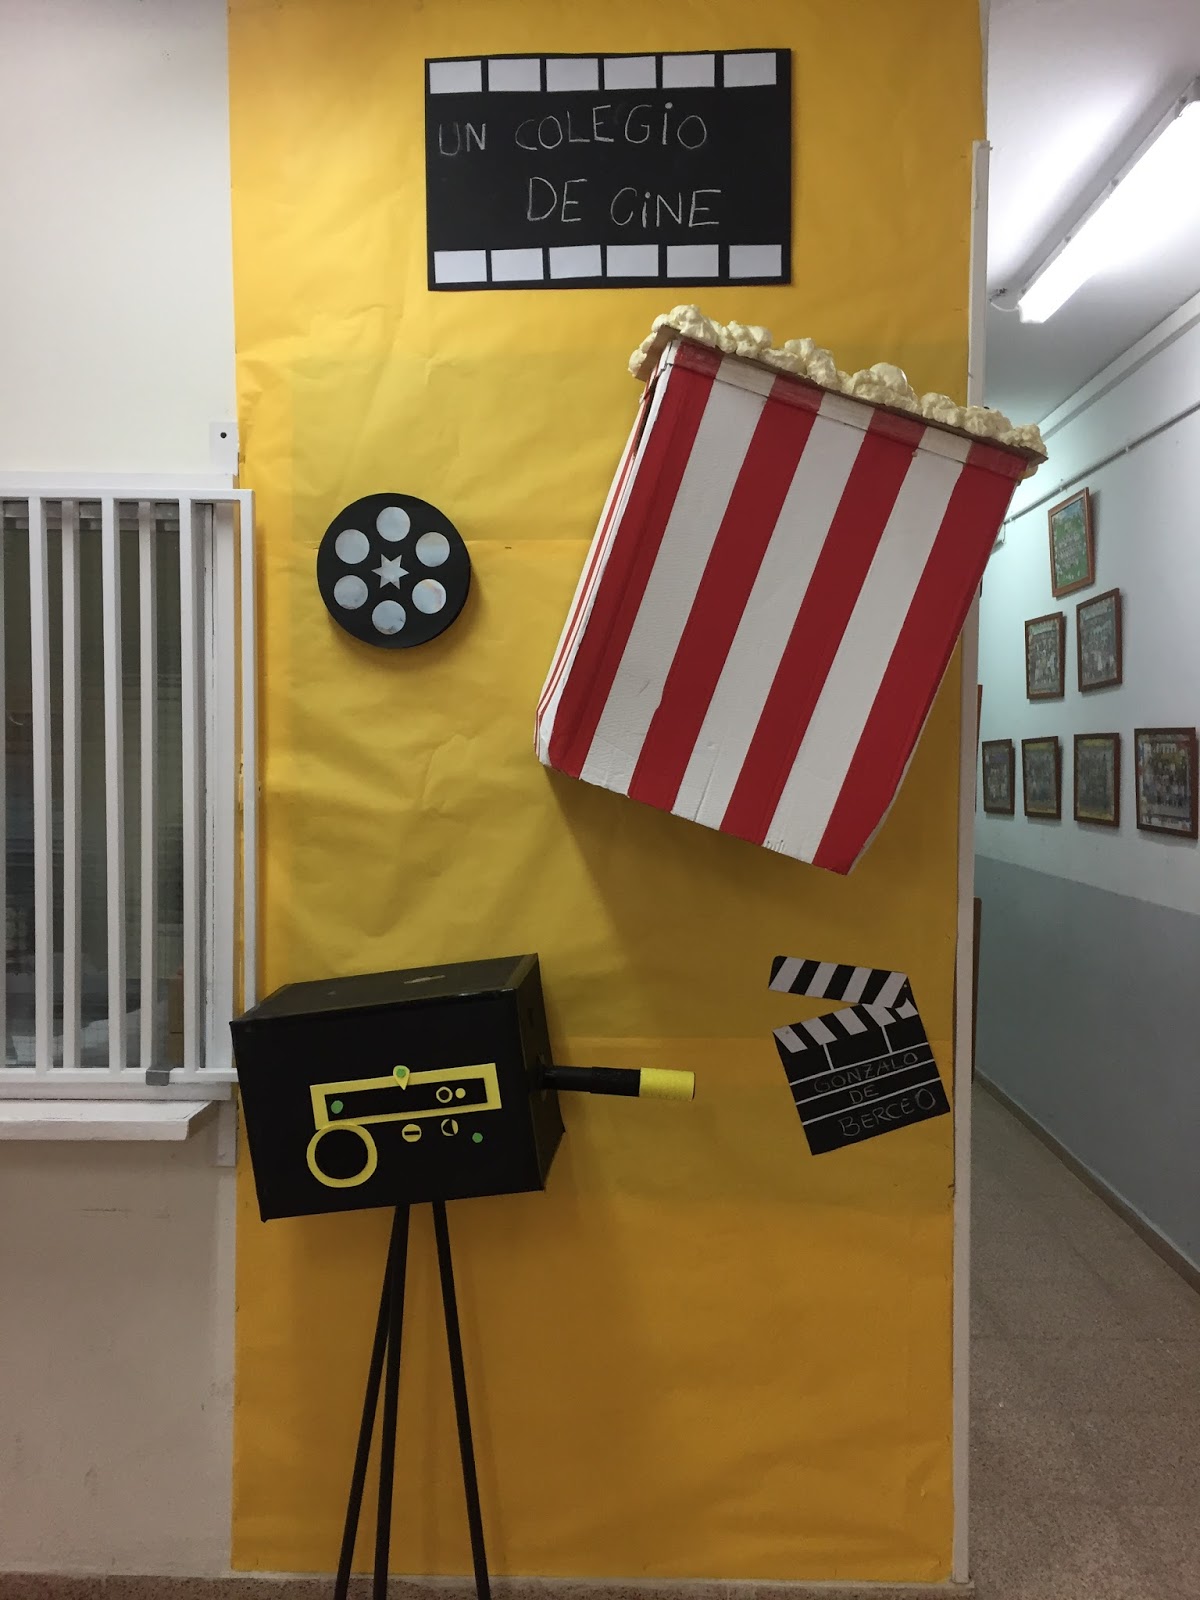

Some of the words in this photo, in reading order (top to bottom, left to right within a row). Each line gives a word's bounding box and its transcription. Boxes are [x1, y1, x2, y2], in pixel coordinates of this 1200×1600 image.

[438, 121, 487, 156] UN
[526, 176, 588, 222] DE
[813, 1051, 919, 1094] GONZALO
[838, 1088, 936, 1137] BERCEO
[849, 1084, 880, 1105] DE
